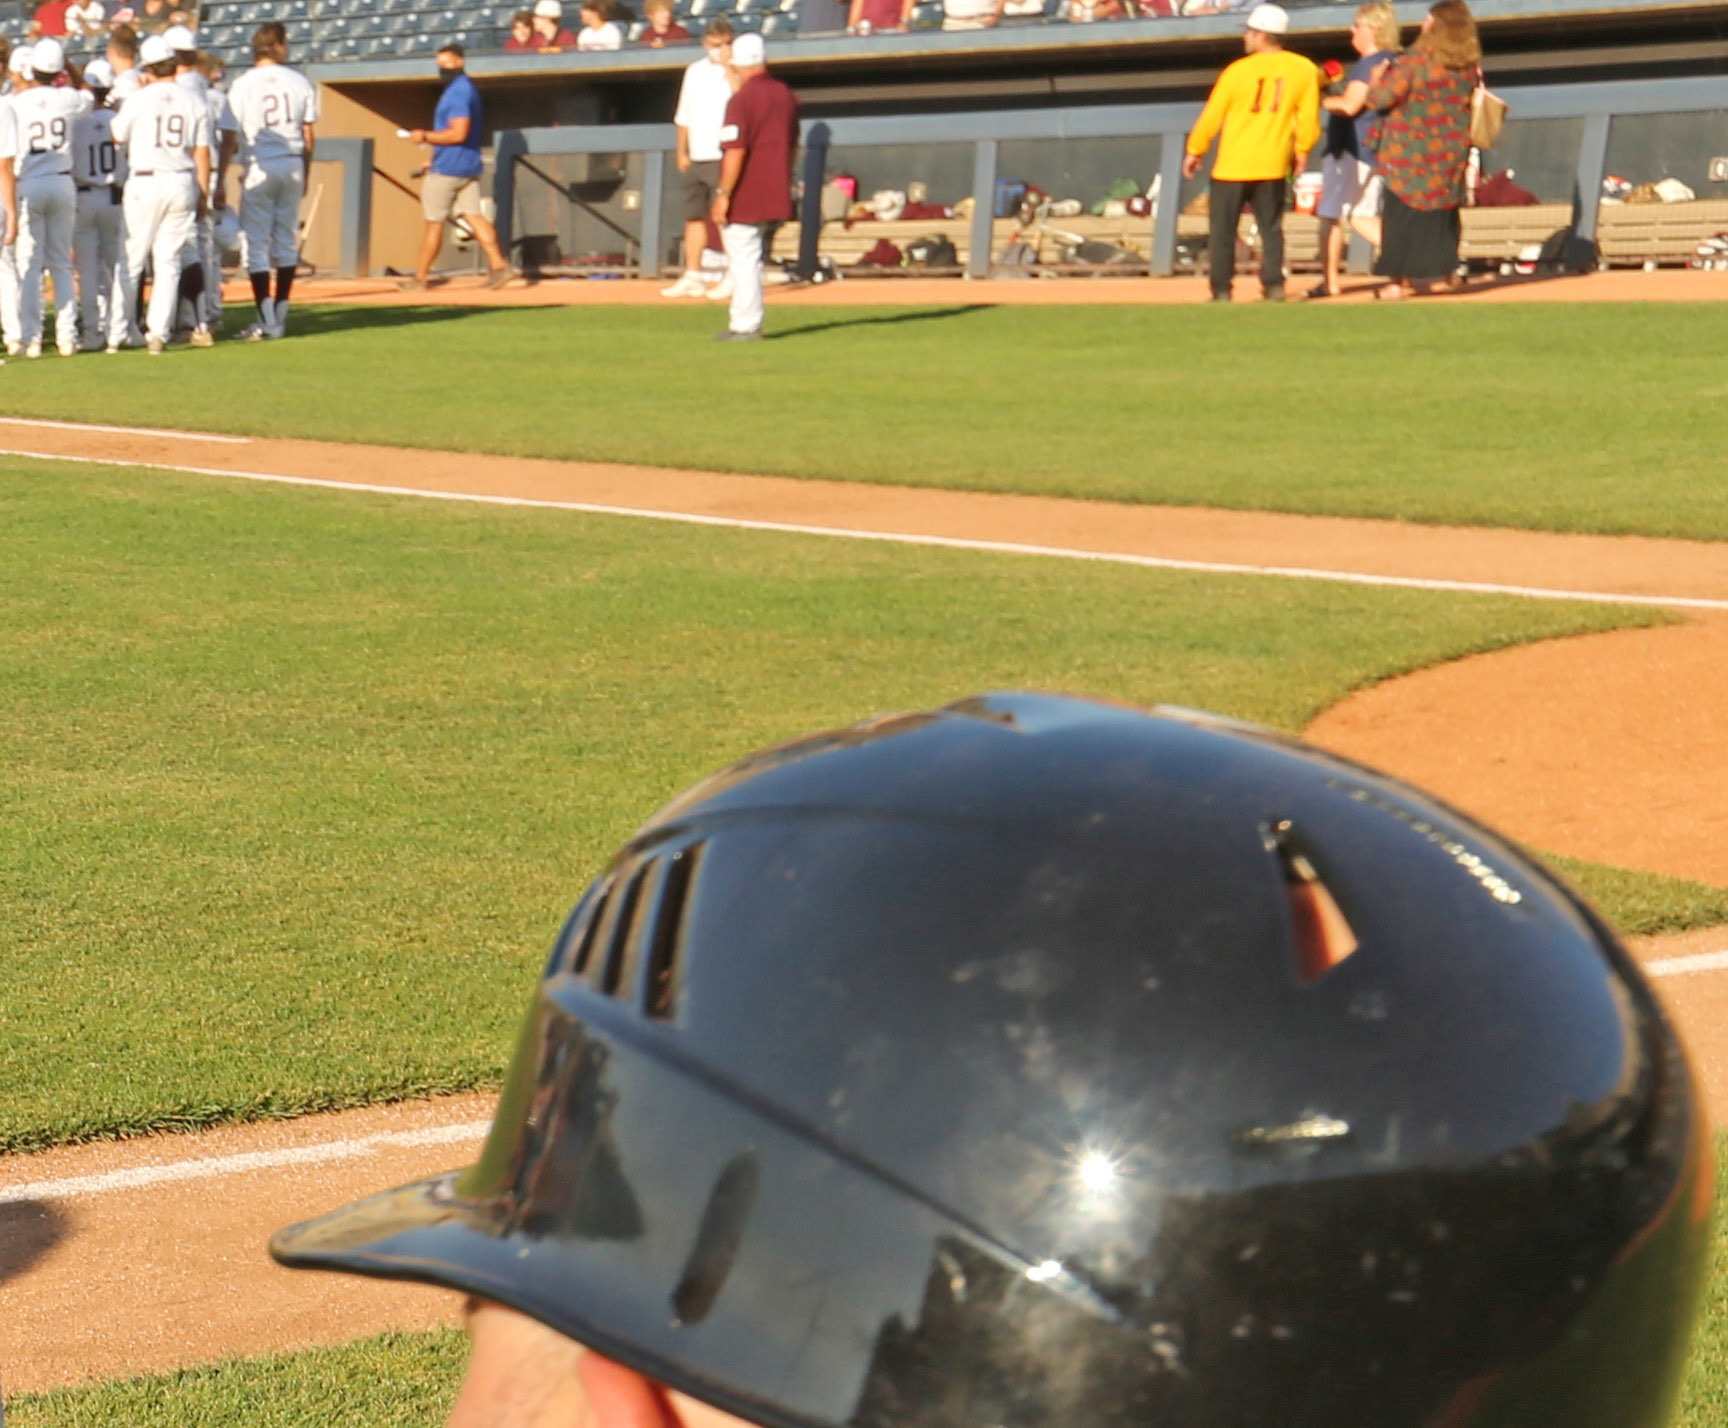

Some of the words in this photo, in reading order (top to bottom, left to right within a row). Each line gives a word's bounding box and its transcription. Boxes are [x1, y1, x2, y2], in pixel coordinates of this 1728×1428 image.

[262, 91, 292, 127] 21
[1250, 76, 1284, 114] 11
[29, 116, 66, 154] 29
[155, 113, 184, 149] 19
[89, 140, 116, 177] 10
